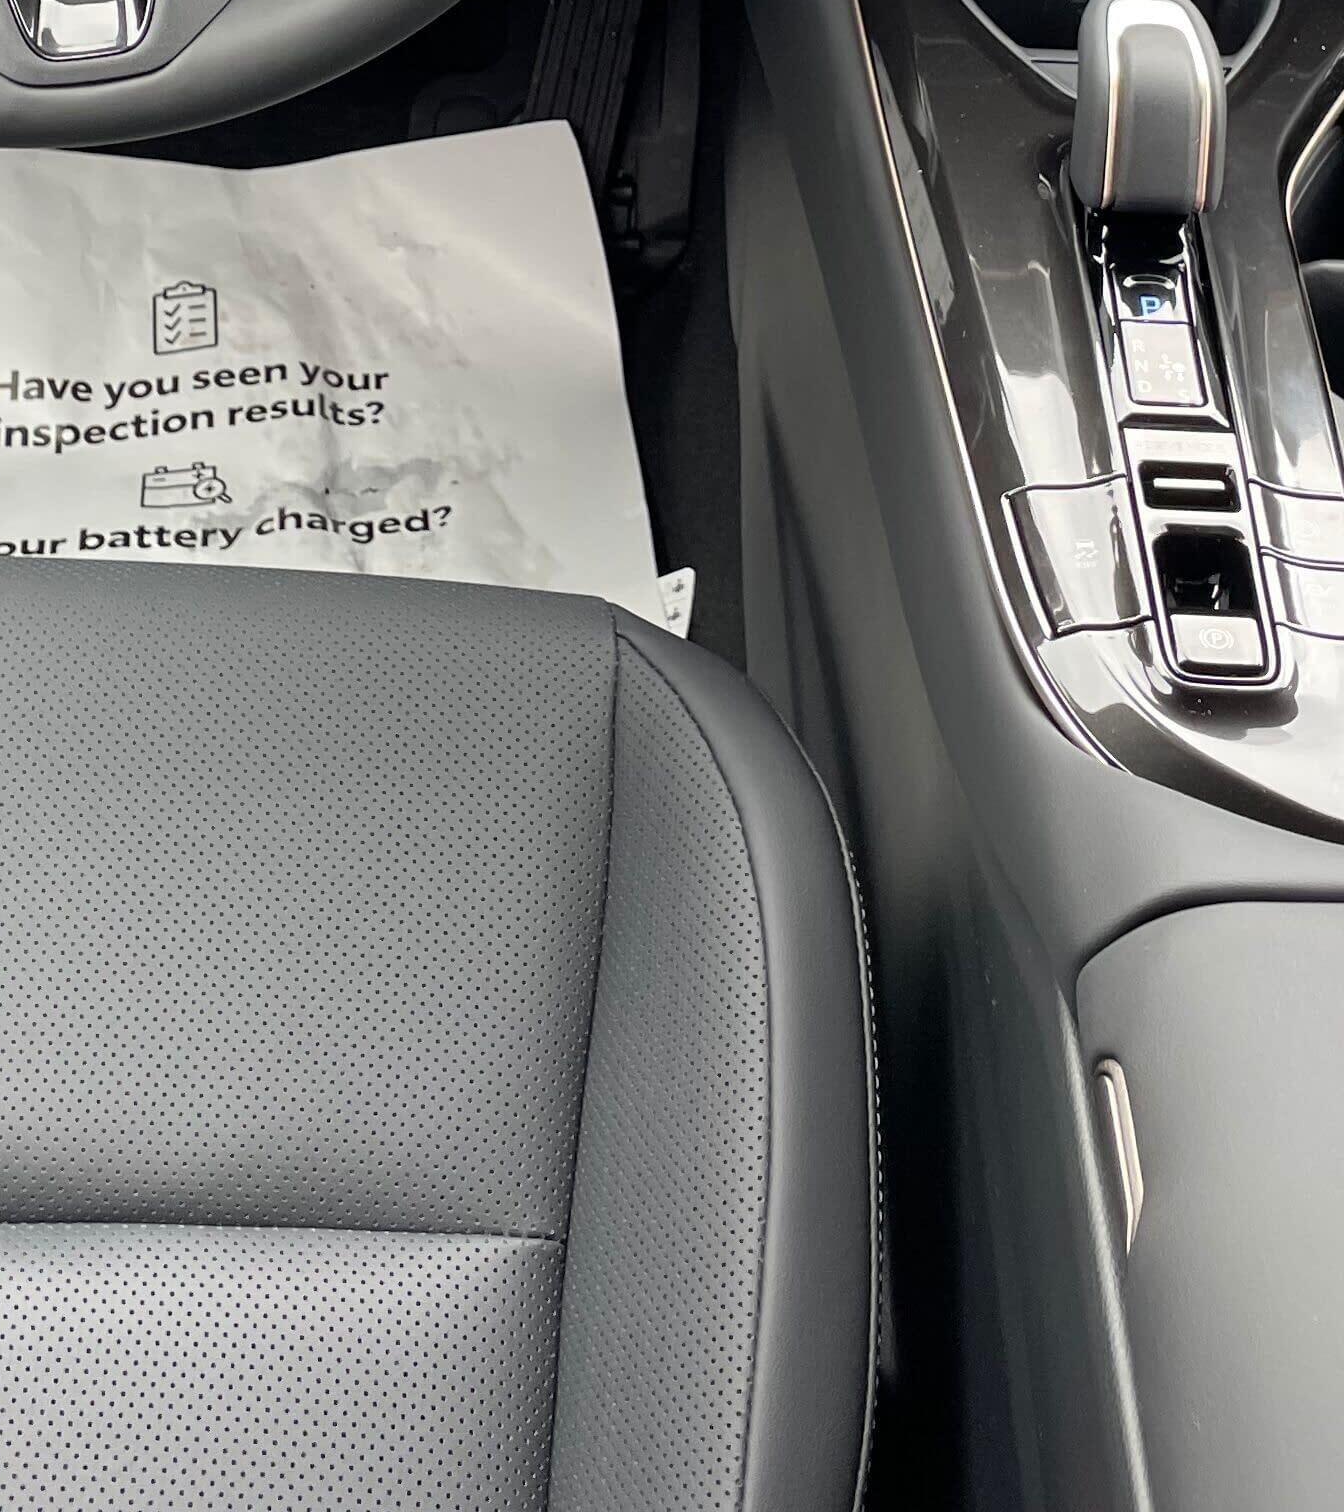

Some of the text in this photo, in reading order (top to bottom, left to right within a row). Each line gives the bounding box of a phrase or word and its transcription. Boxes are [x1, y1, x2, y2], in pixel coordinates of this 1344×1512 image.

[1139, 295, 1162, 316] P
[104, 372, 180, 410] you
[192, 362, 288, 391] seen
[299, 360, 389, 391] your
[227, 392, 385, 427] results?
[79, 525, 244, 551] battery
[255, 504, 453, 544] charged?
